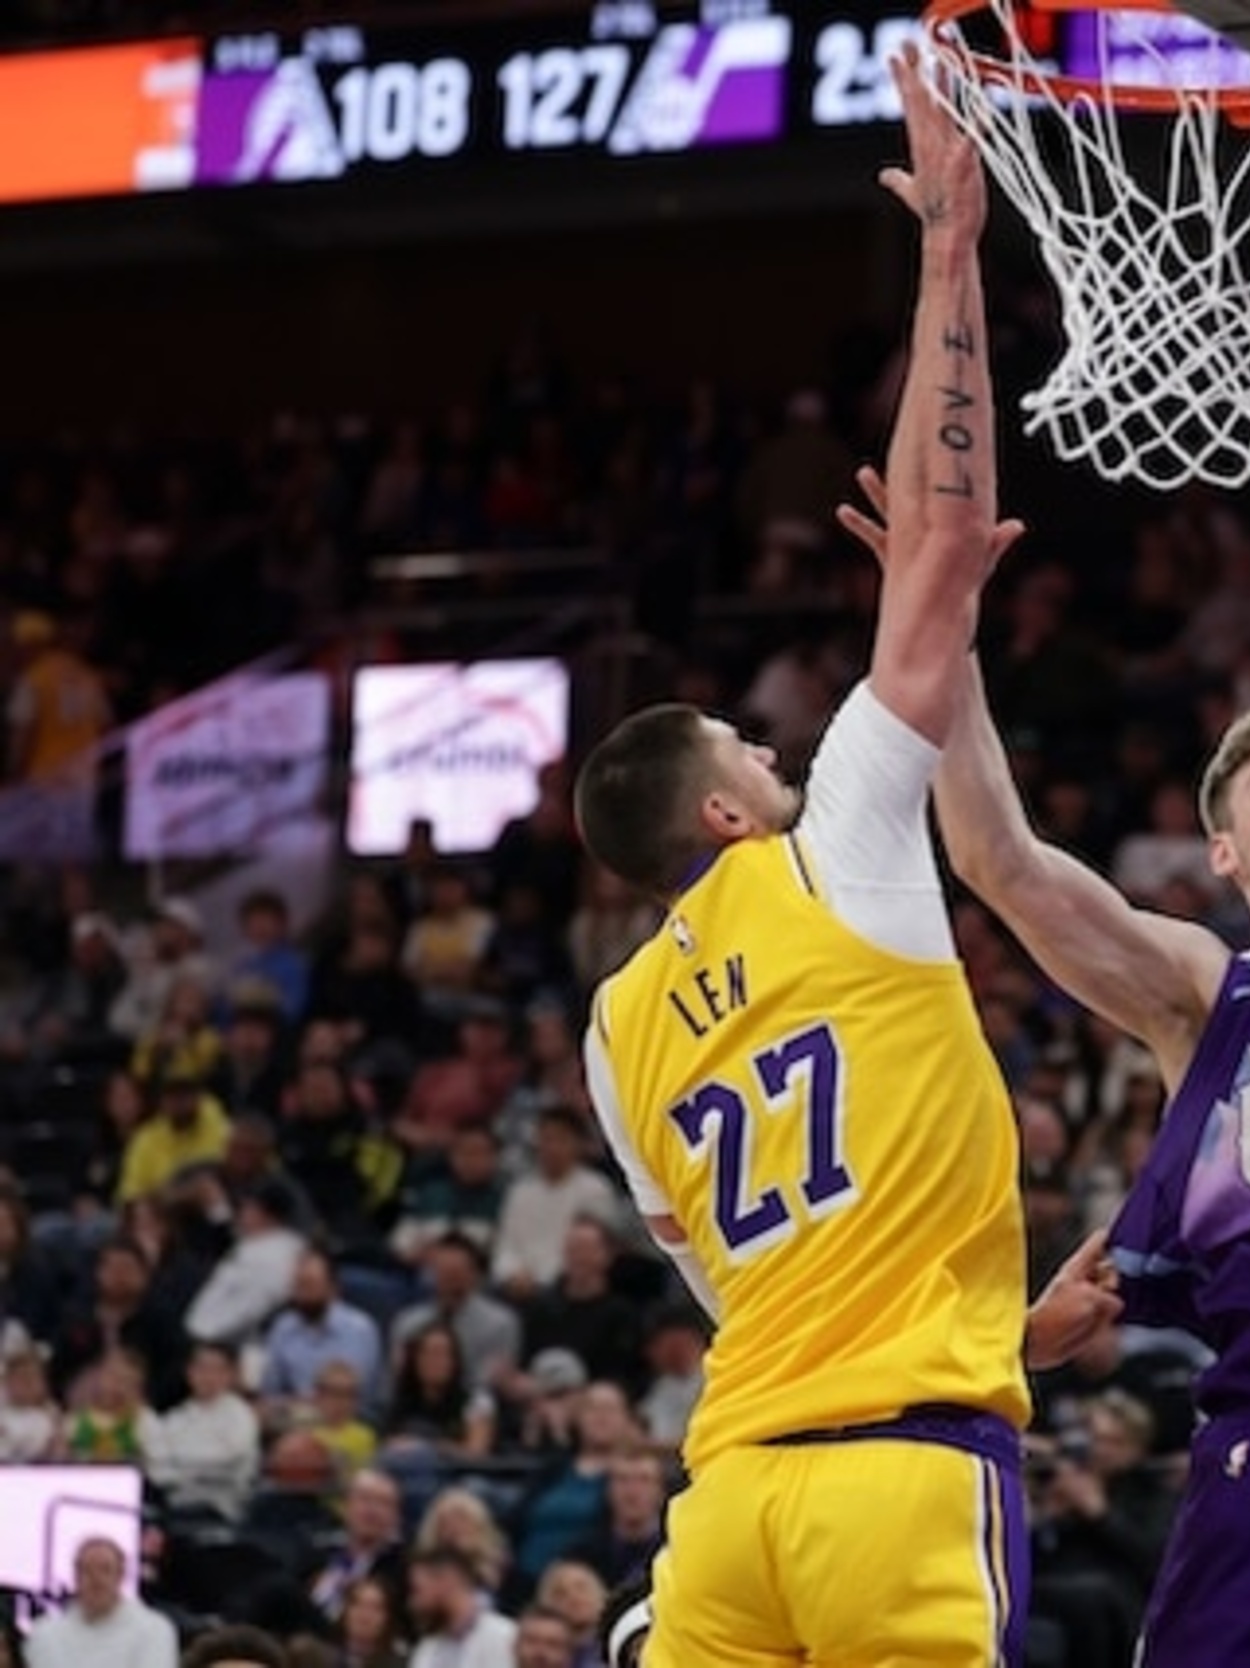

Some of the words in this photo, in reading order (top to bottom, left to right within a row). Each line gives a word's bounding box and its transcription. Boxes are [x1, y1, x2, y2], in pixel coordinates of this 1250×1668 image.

[335, 58, 470, 163] 108
[497, 45, 630, 147] 127
[668, 953, 748, 1038] LEN
[668, 1022, 852, 1250] 27
